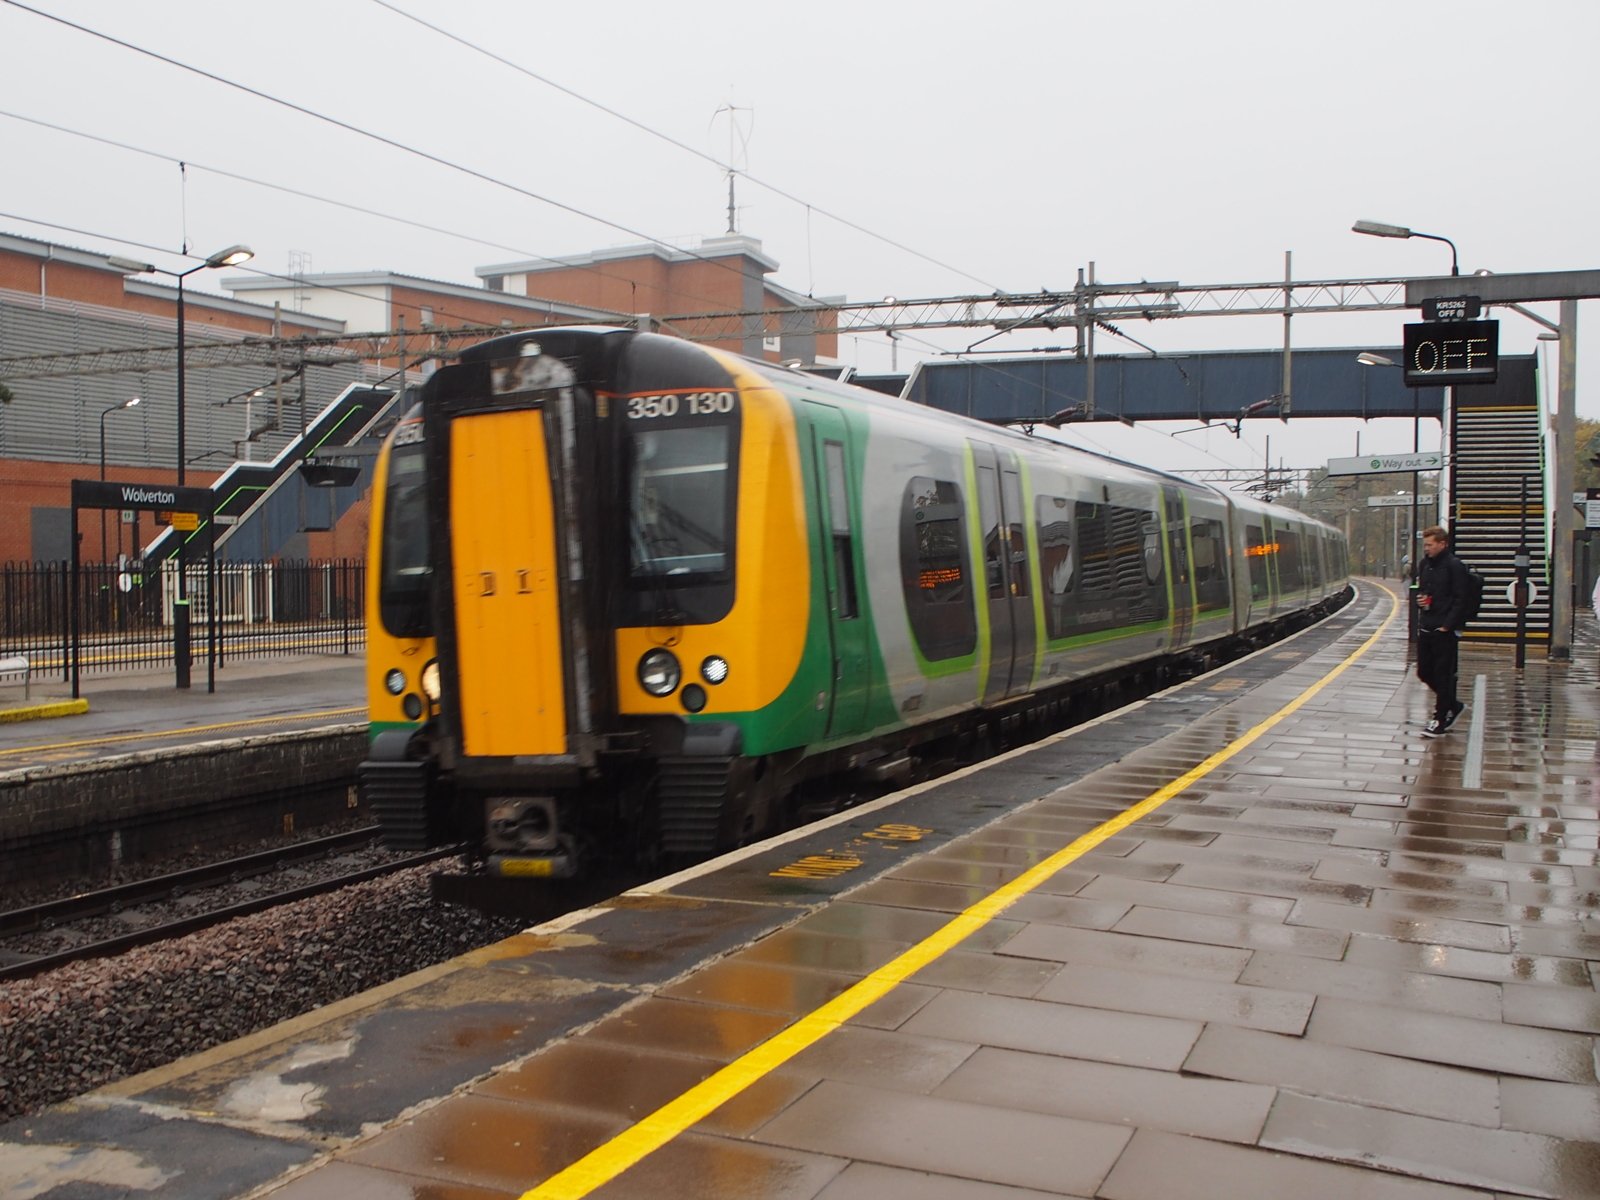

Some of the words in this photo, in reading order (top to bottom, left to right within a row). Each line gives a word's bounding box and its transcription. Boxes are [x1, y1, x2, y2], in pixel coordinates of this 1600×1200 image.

[1438, 310, 1456, 318] OFF
[1414, 338, 1488, 374] OFF
[626, 394, 680, 419] 350
[684, 391, 735, 414] 130
[1382, 459, 1403, 470] Way
[1405, 459, 1422, 467] out
[121, 486, 175, 504] Wolverton
